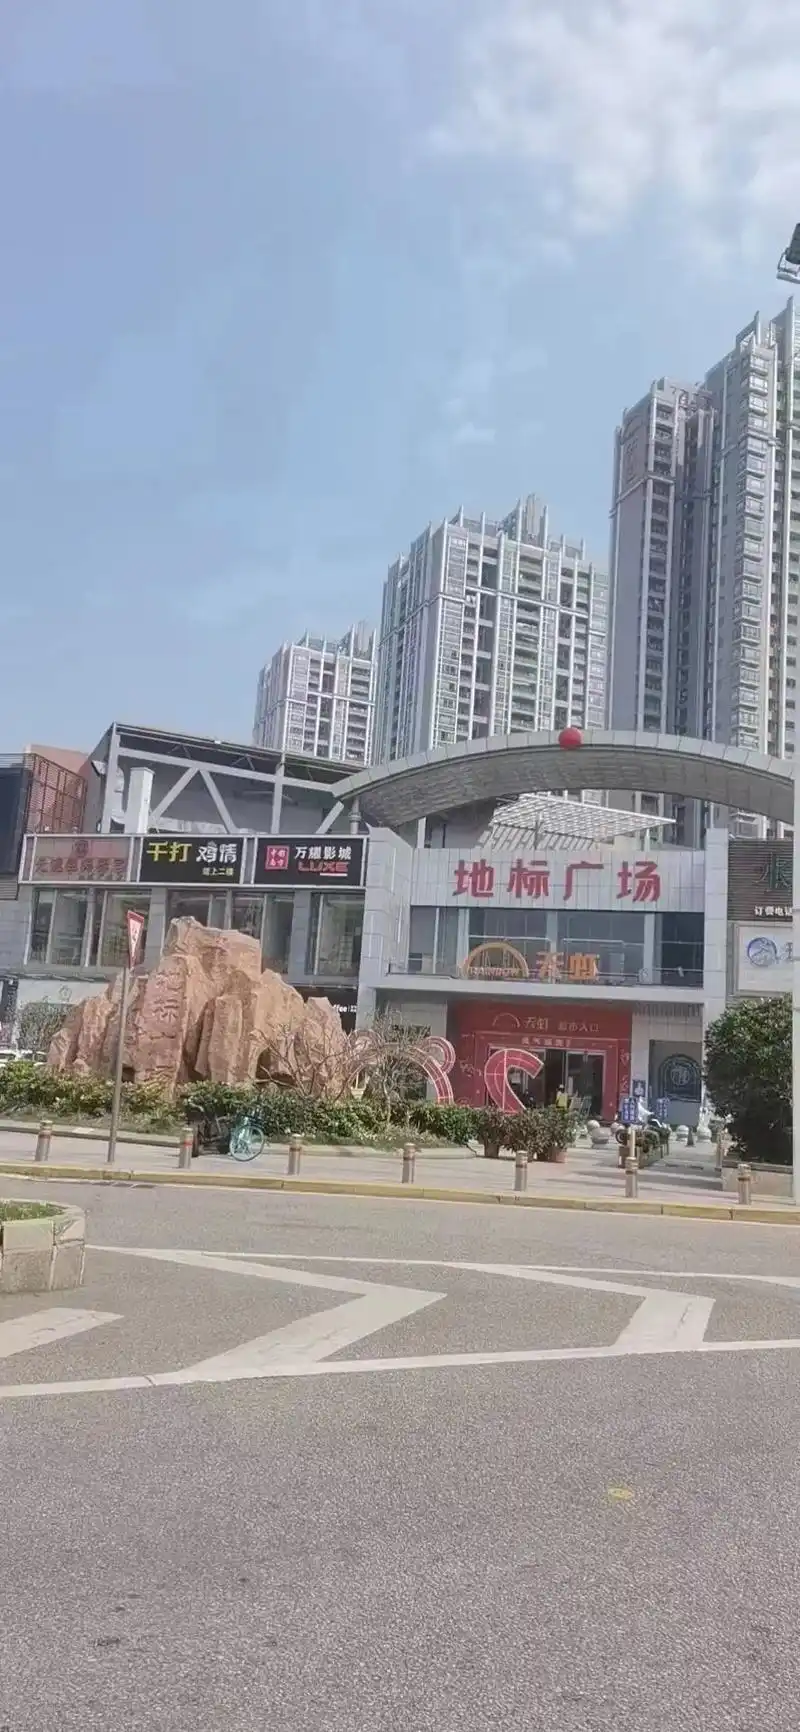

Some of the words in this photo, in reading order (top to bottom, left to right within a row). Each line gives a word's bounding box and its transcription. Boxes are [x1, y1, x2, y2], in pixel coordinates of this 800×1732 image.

[298, 861, 349, 872] LUXE
[452, 858, 661, 902] 地标广场
